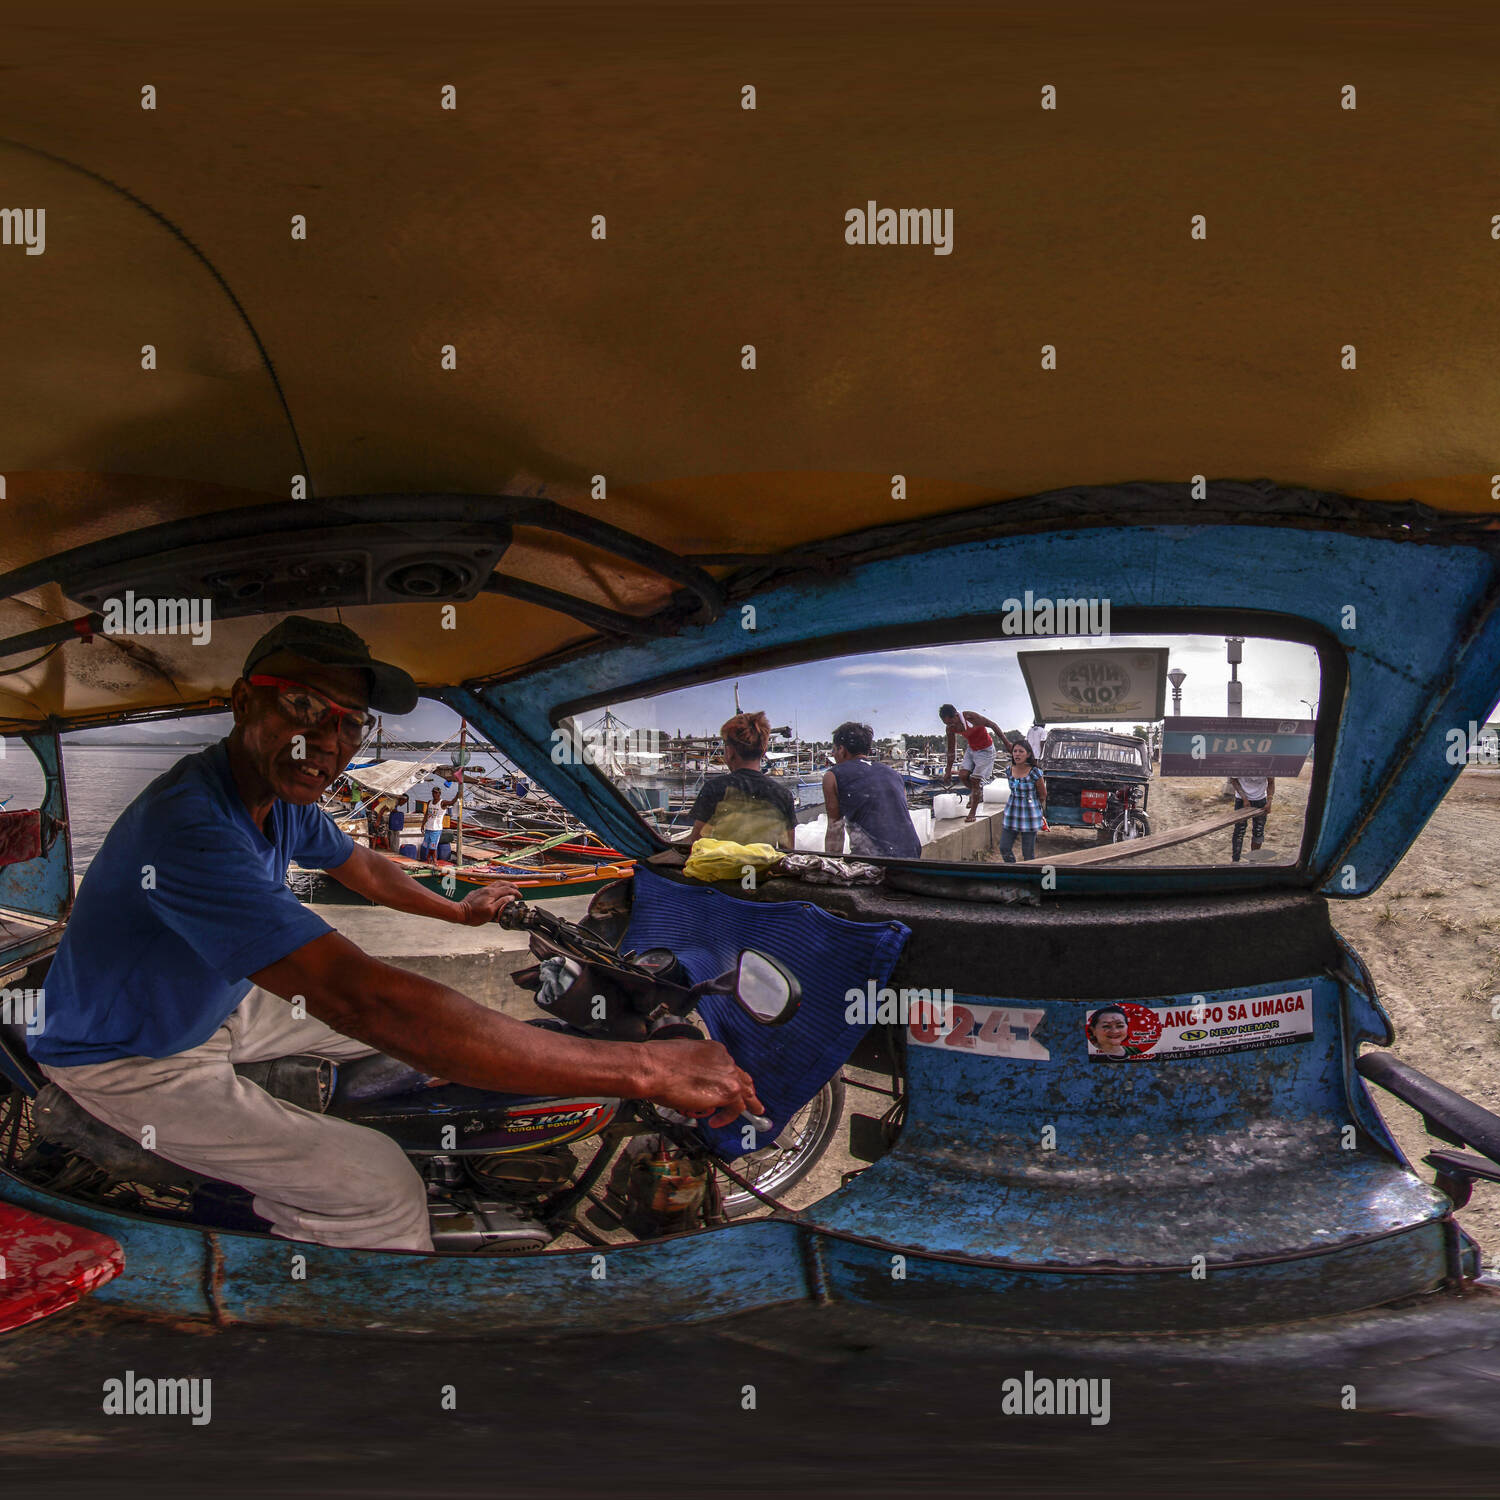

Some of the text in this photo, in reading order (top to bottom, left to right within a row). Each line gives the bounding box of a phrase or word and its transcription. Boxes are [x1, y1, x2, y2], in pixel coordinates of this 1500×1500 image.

[1202, 1007, 1223, 1024] PO
[1227, 1004, 1248, 1021] SA
[1251, 995, 1305, 1018] UMAGA
[1209, 1026, 1238, 1038] NEW
[1239, 1020, 1280, 1033] NEMAR
[1163, 1037, 1296, 1060] SALES SERVICE SPARE PARTS
[507, 1118, 581, 1133] TORQUE POWER
